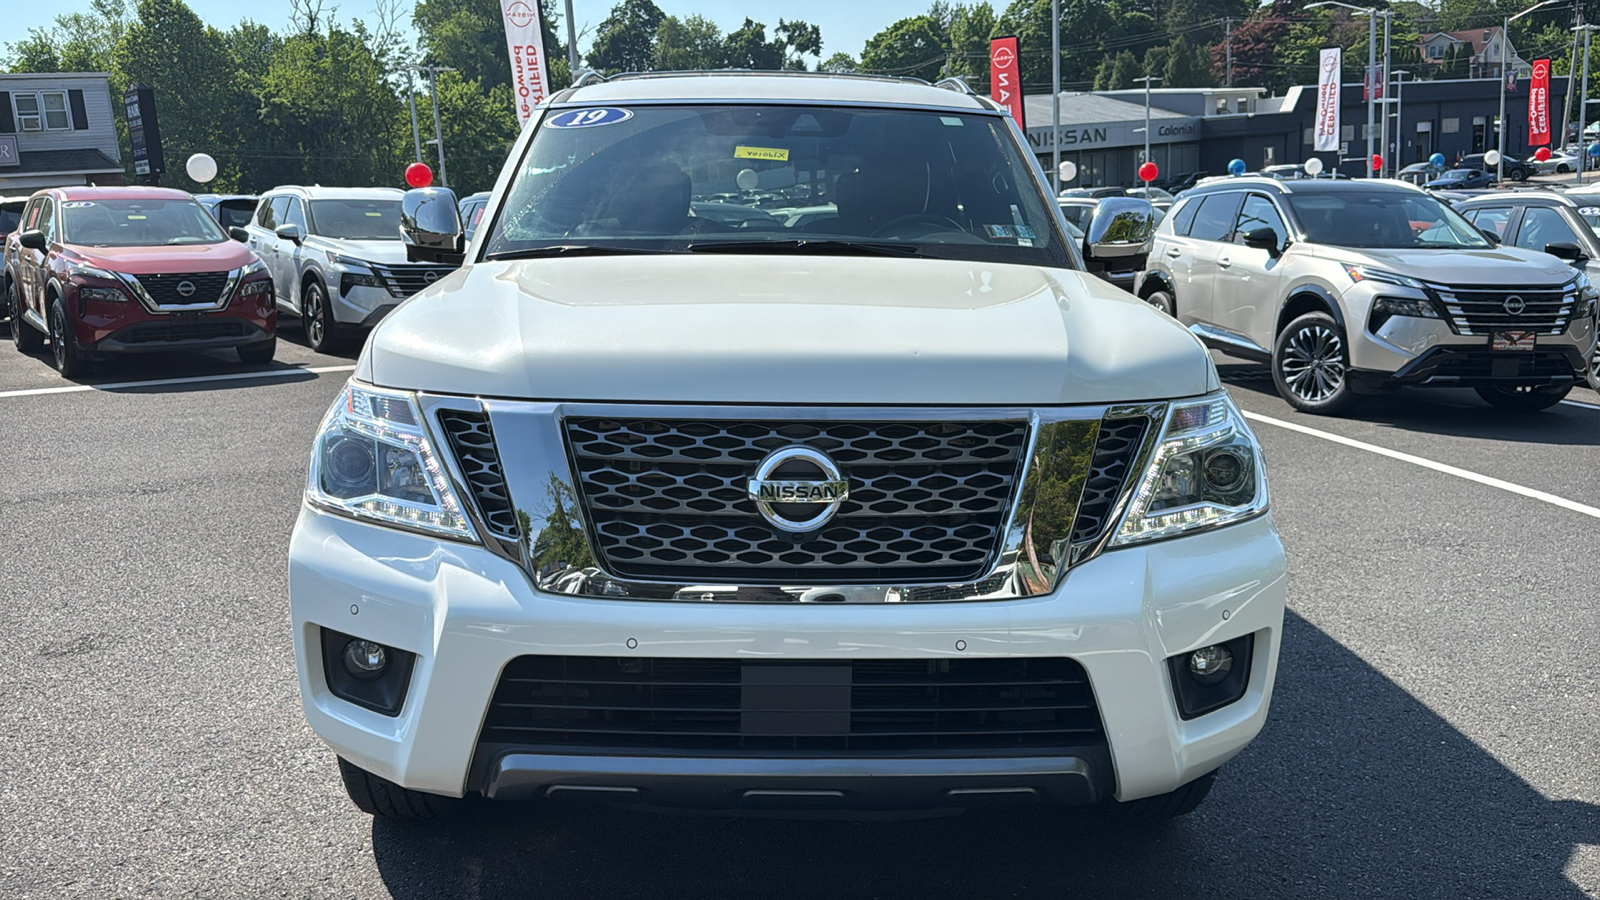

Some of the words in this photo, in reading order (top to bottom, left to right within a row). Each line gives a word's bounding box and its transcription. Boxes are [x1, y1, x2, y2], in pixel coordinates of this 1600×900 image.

[567, 109, 608, 126] 19
[1158, 123, 1196, 136] Colonial
[760, 485, 838, 498] NISSAN
